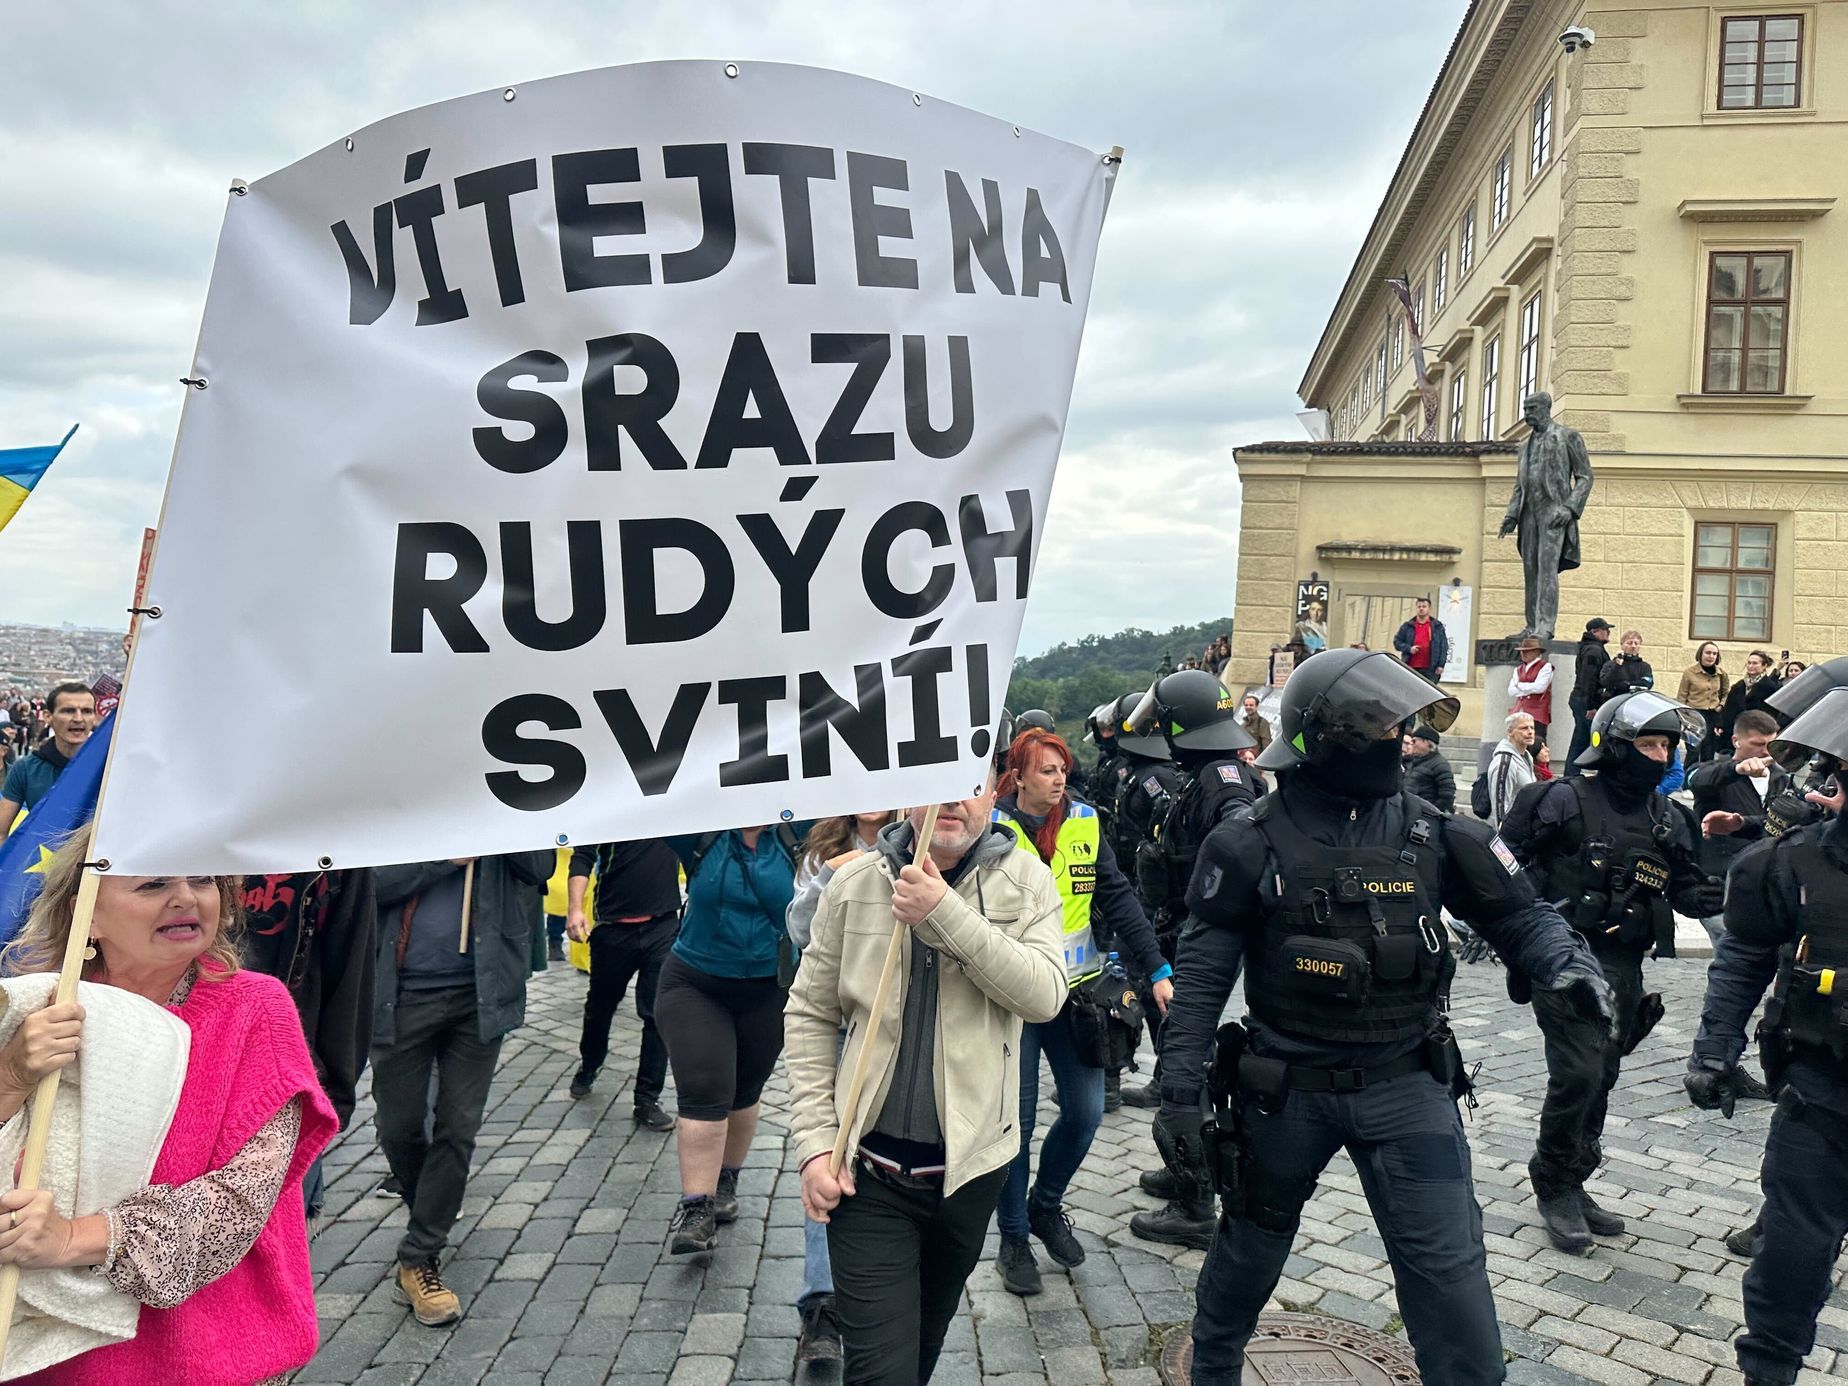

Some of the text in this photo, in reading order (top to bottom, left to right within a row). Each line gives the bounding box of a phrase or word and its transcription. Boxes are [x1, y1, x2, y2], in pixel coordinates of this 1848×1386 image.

[329, 141, 1073, 327] VÍTEJTE NA
[472, 331, 975, 475] SRAZU
[390, 475, 1033, 654] RUDÝCH
[481, 617, 992, 812] SVINÍ!
[1636, 860, 1669, 880] POLICIE
[1295, 957, 1344, 977] 330057
